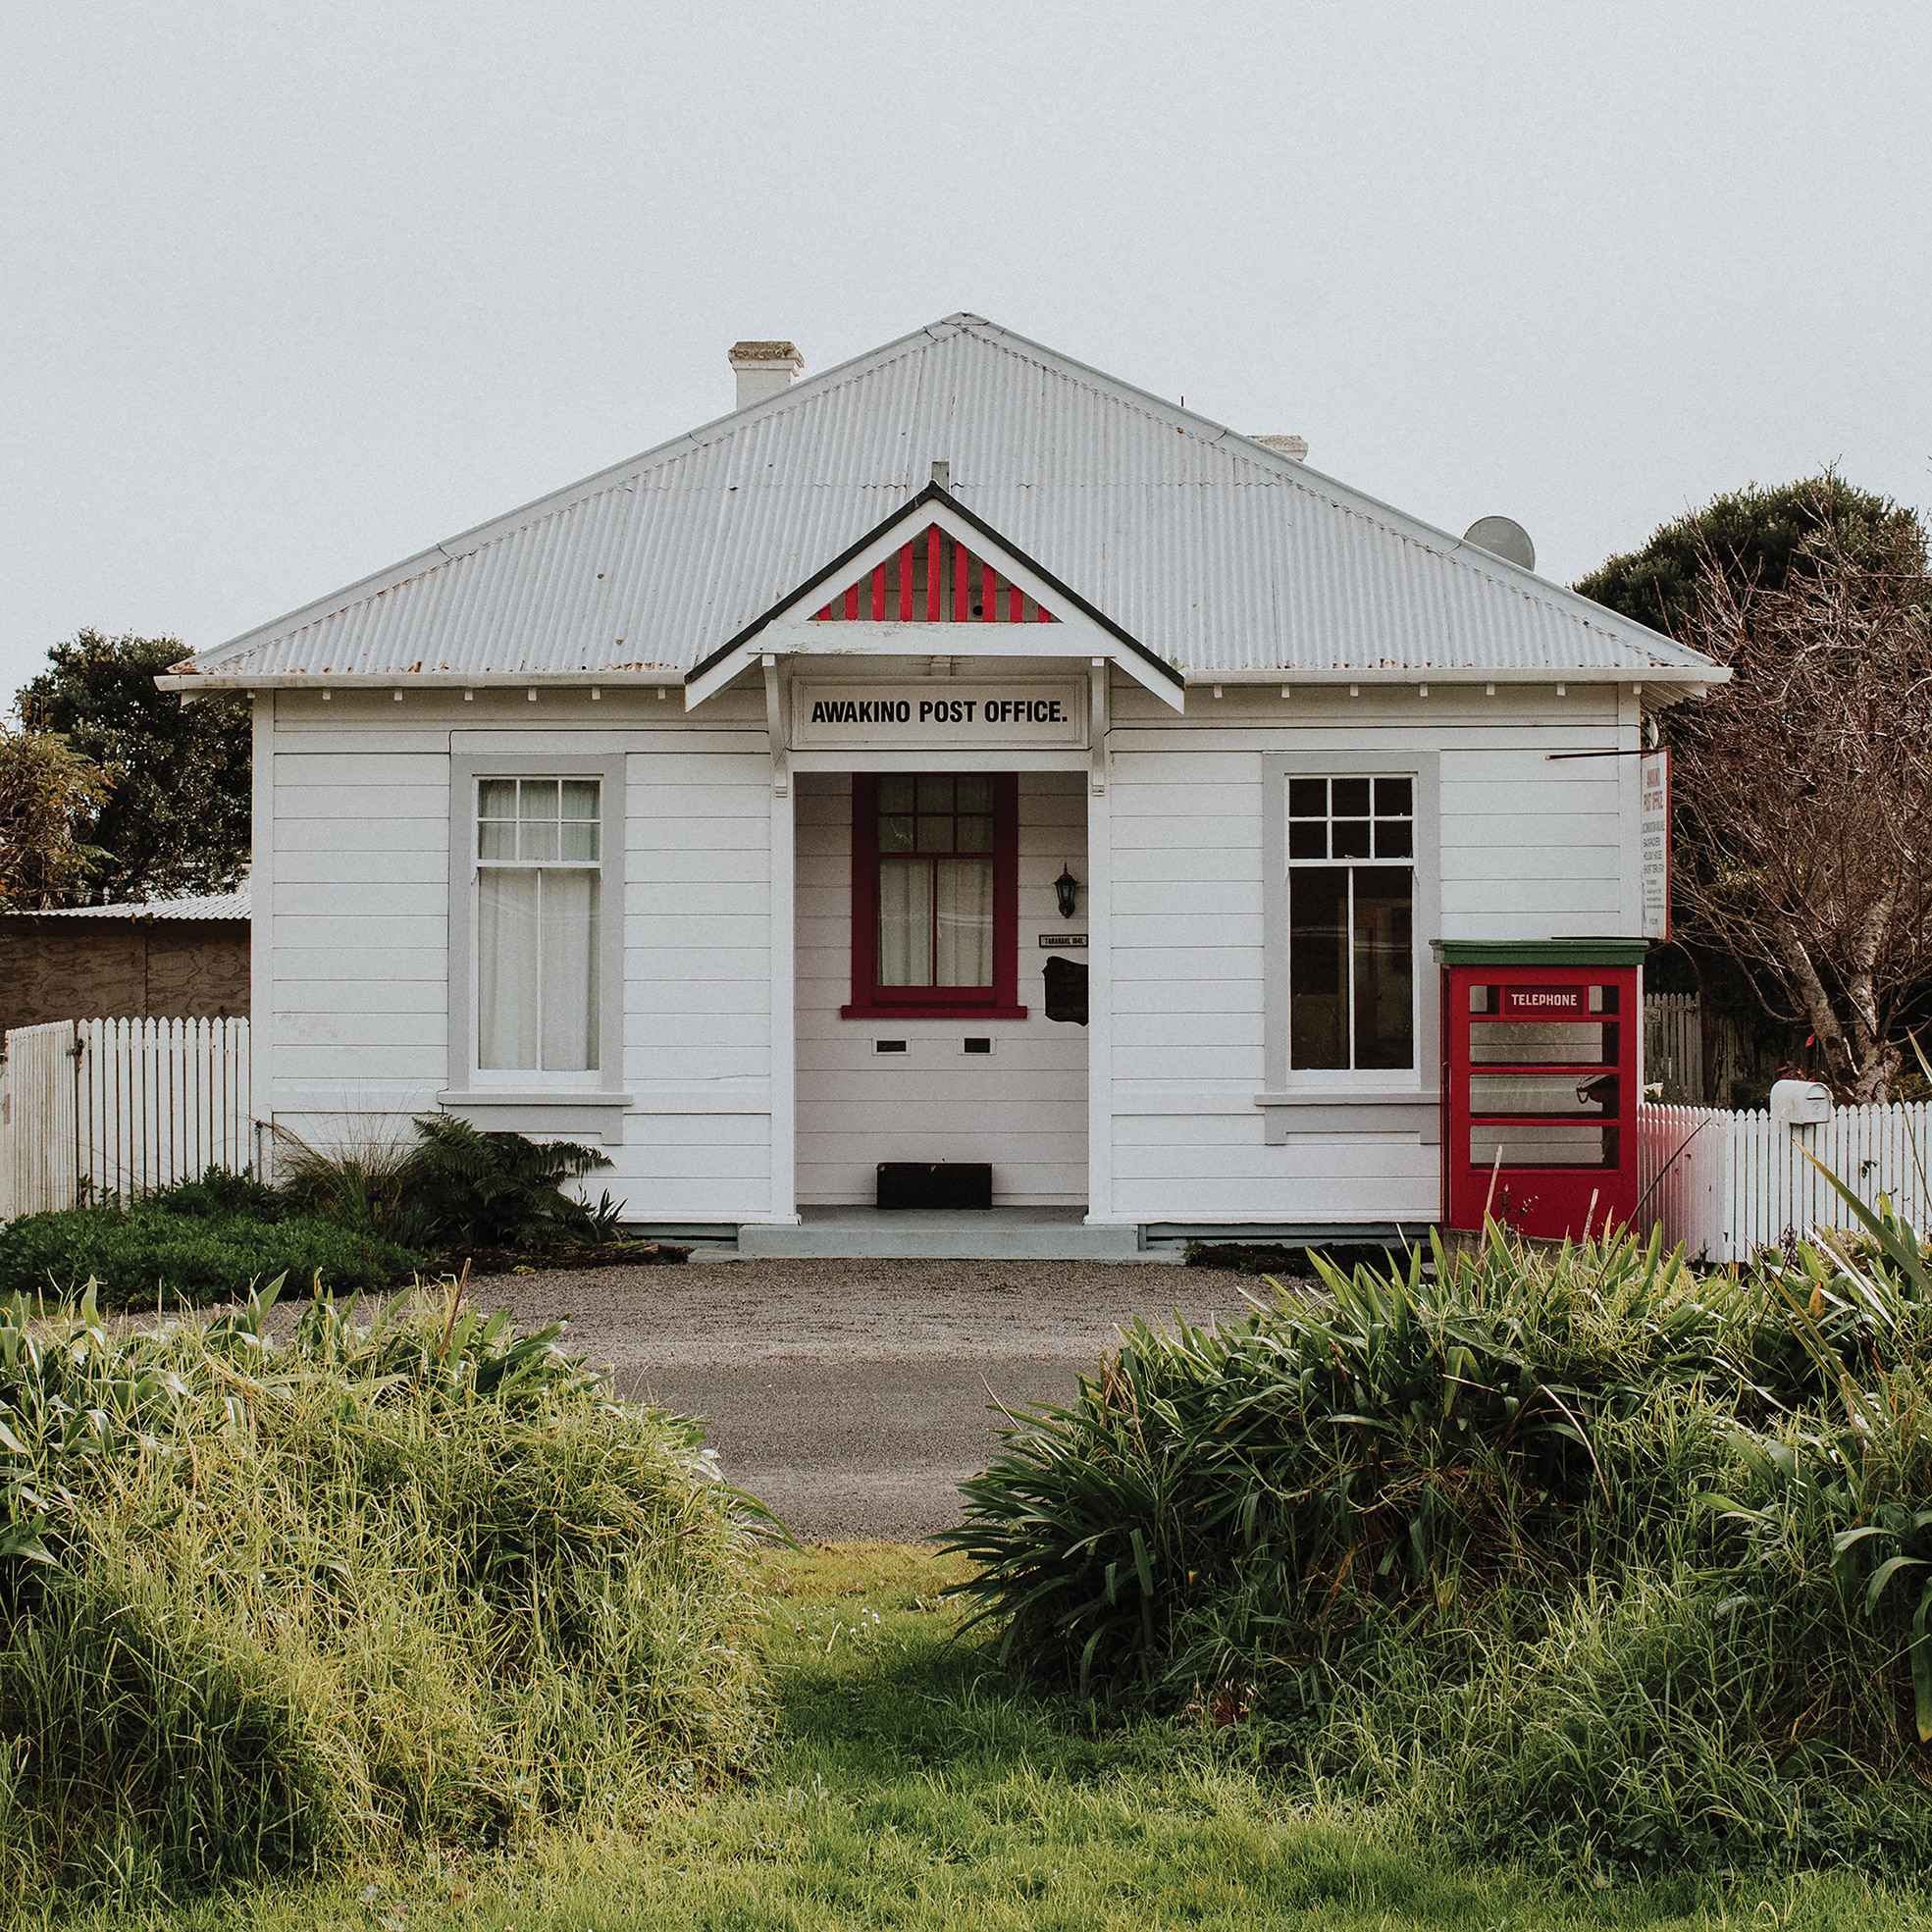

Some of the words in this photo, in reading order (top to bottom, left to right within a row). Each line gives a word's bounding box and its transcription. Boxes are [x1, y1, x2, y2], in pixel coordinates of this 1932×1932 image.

[810, 700, 911, 723] AWAKINO
[919, 700, 977, 723] POST
[984, 700, 1068, 723] OFFICE.
[1511, 994, 1578, 1006] TELEPHONE
